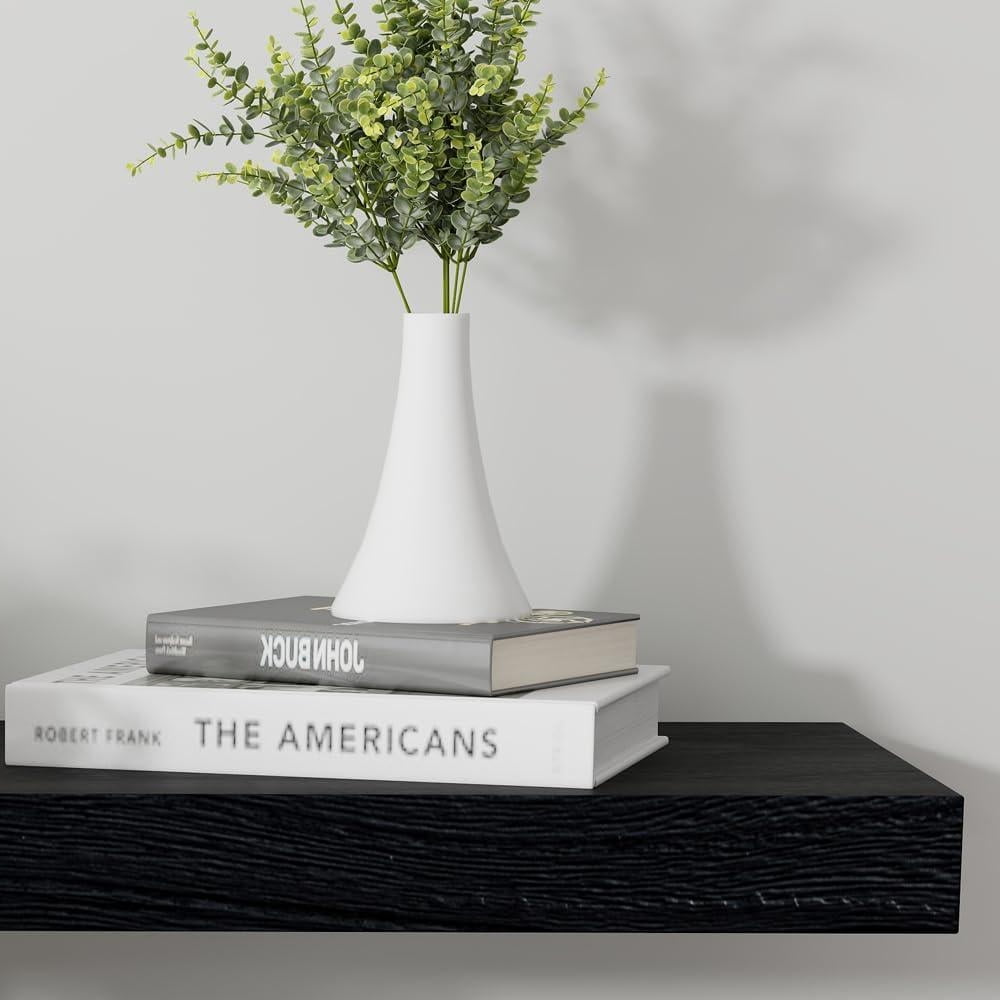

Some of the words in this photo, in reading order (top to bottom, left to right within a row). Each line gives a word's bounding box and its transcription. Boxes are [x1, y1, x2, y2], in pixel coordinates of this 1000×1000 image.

[33, 725, 99, 744] ROBERT
[105, 728, 161, 746] FRANK
[195, 718, 260, 750] THE
[278, 723, 499, 759] AMERICANS
